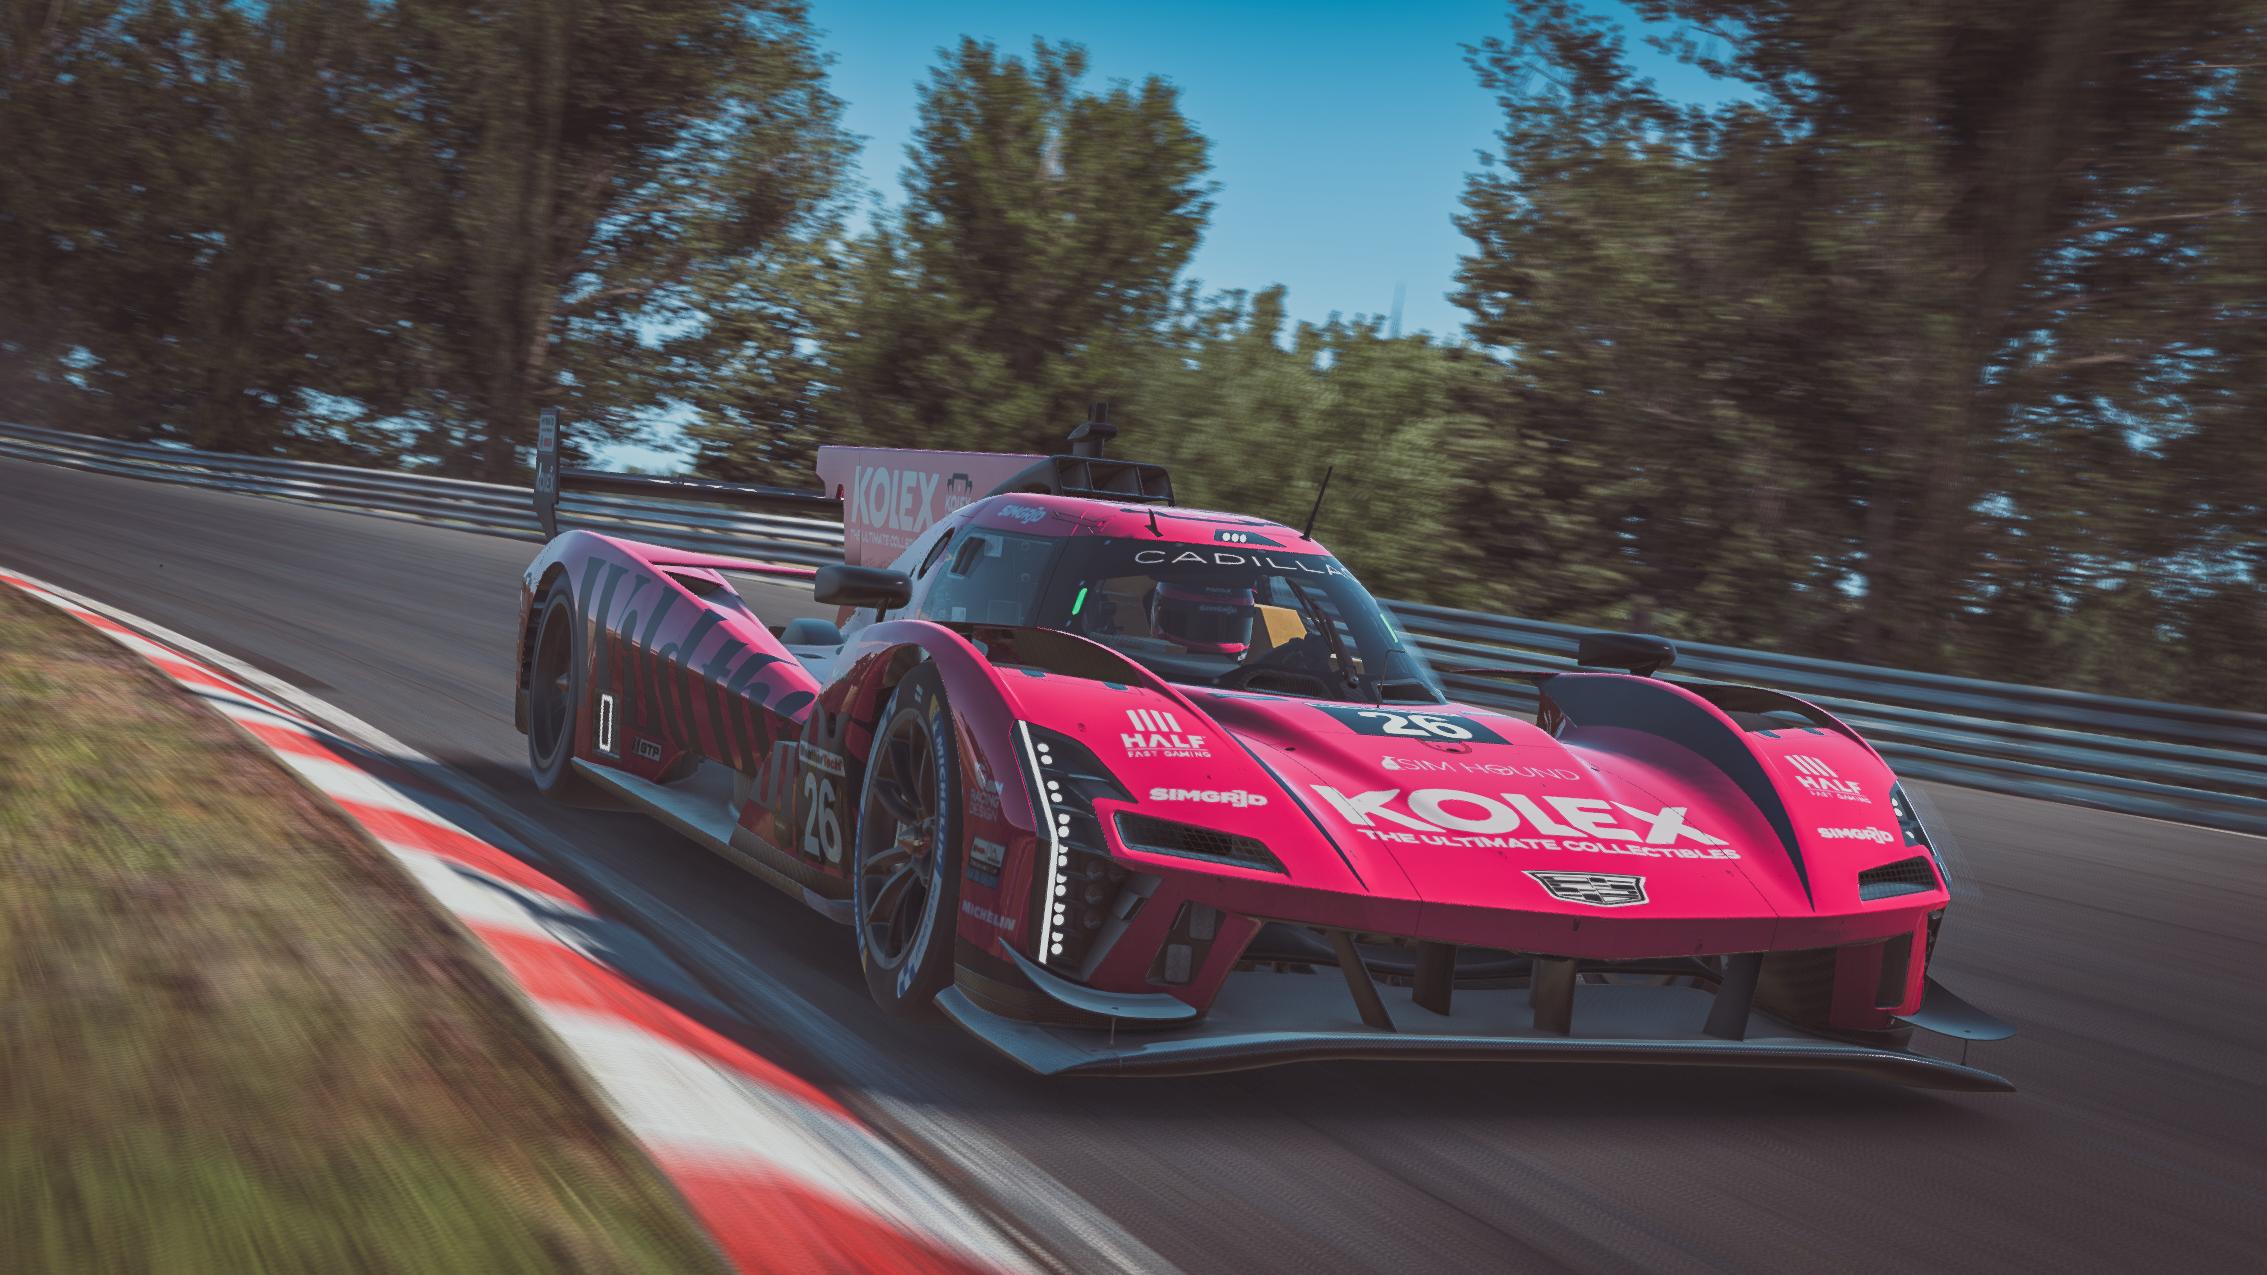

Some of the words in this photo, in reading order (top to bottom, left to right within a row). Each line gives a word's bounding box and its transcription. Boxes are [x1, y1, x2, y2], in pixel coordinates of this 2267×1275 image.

[852, 465, 940, 532] KOLEX
[1120, 733, 1205, 748] HALF
[1358, 711, 1472, 740] 26
[640, 742, 659, 757] GTP
[1128, 750, 1157, 758] FAST
[1399, 760, 1452, 774] SIM
[1460, 764, 1581, 782] HOUND
[1795, 775, 1861, 793] HALF
[936, 736, 947, 864] MICHELIN
[804, 771, 842, 864] 26
[1310, 785, 1729, 846] KOLEX
[1357, 828, 1419, 844] THE
[1418, 833, 1560, 851] ULTIMATE
[1562, 839, 1741, 860] COLLECTIBLES
[961, 899, 1017, 931] MICHELIN
